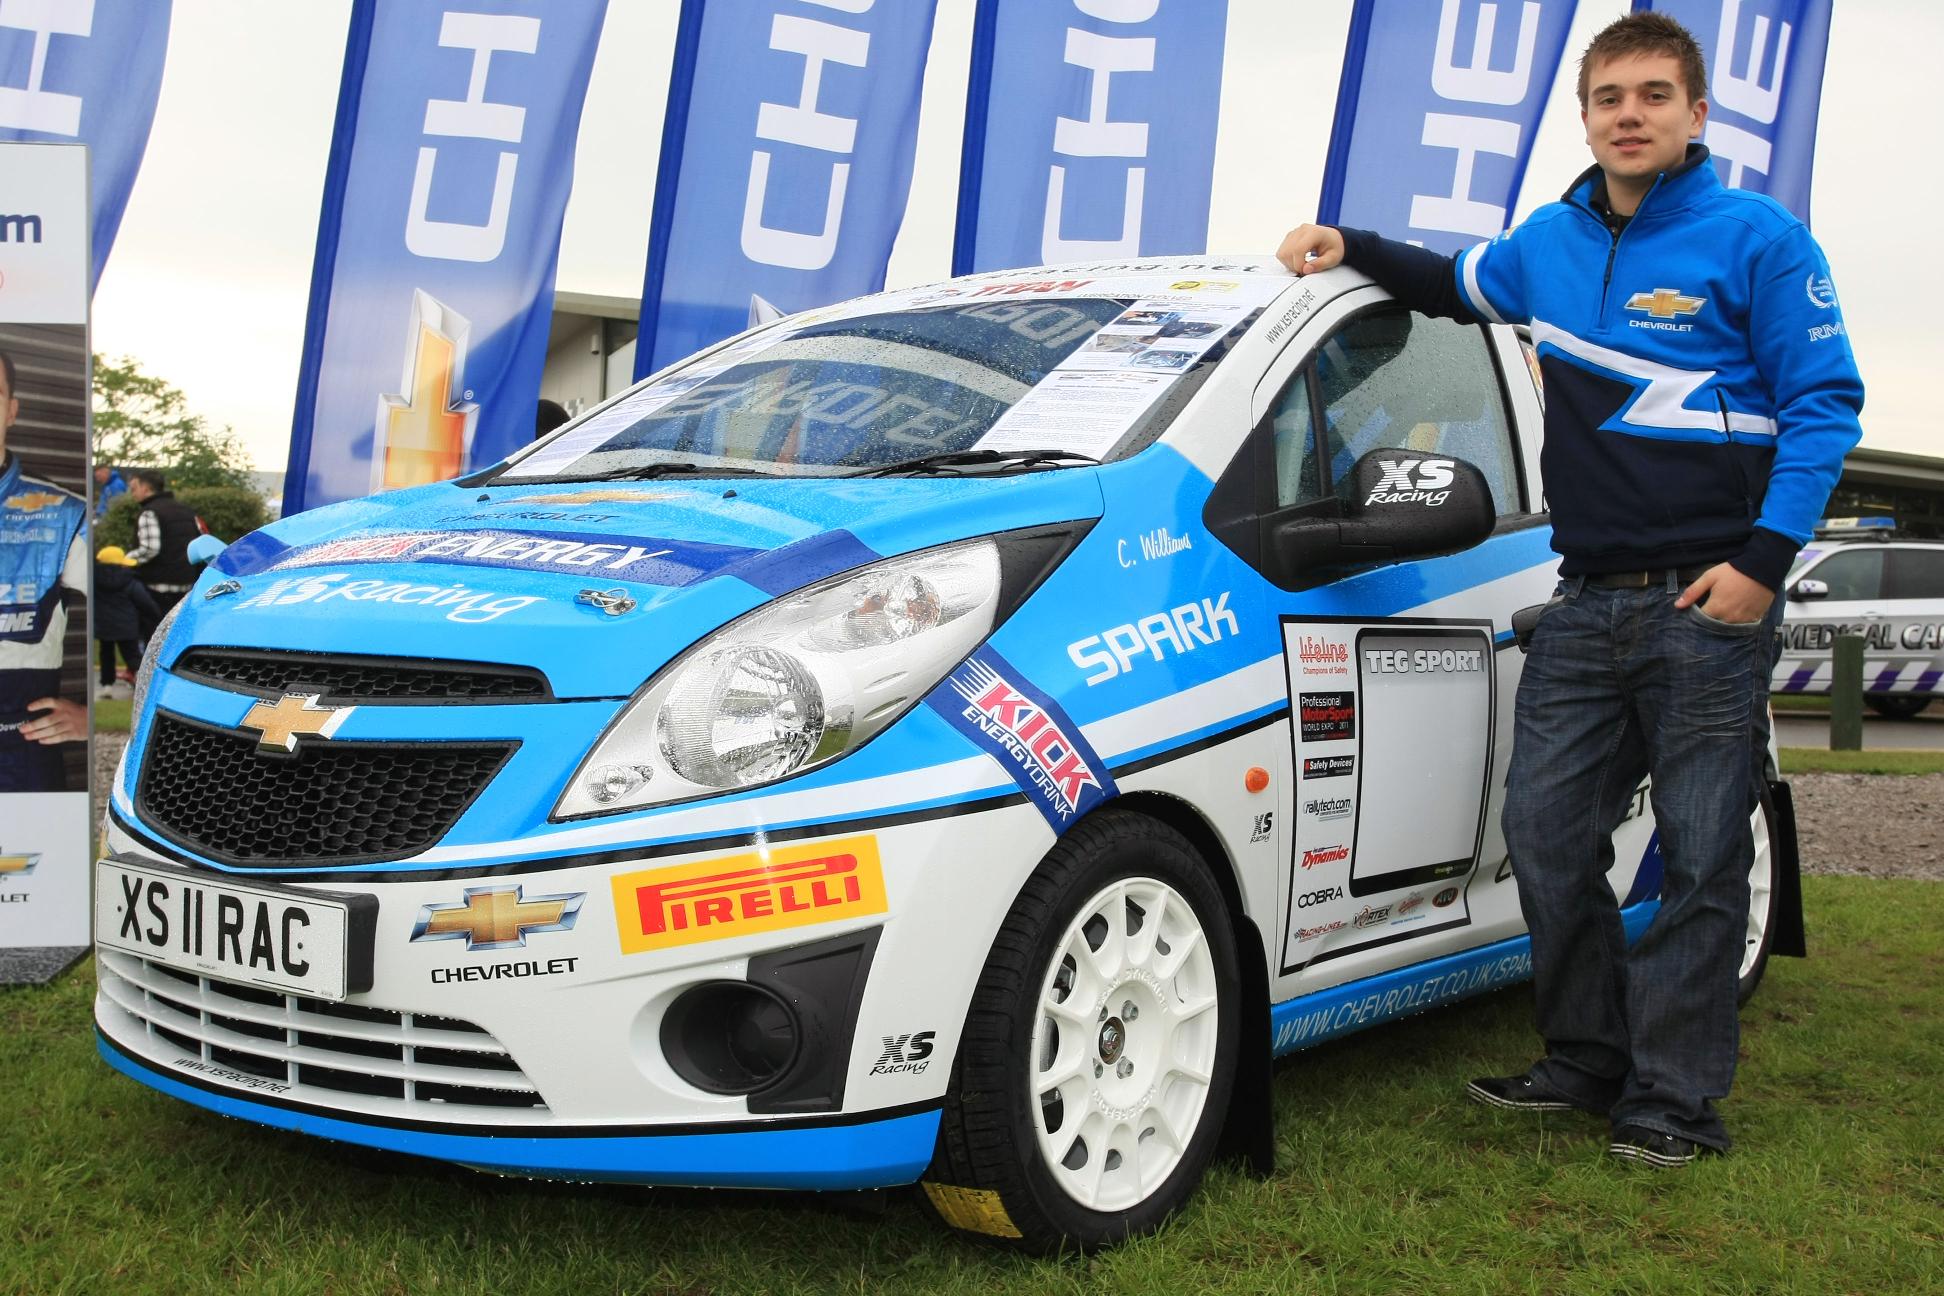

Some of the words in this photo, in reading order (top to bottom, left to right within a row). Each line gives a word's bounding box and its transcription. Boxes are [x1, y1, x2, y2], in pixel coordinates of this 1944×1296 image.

[740, 0, 876, 271] CH
[1403, 0, 1540, 248] HE
[1264, 287, 1316, 344] www.xsracing.net
[1628, 319, 1694, 332] CHEVROLET
[1370, 459, 1455, 493] XS
[1364, 489, 1453, 507] Racing
[5, 511, 58, 521] CHEVROLET
[418, 531, 672, 571] ENERGY
[1117, 538, 1137, 569] C.
[1139, 526, 1193, 562] Williams
[322, 581, 548, 623] Racing
[1066, 591, 1241, 687] SPARK
[1300, 636, 1348, 663] lifeline
[1303, 667, 1328, 676] Champions
[1334, 665, 1348, 676] Safety
[1365, 650, 1409, 674] TEG
[1414, 649, 1484, 673] SPORT
[1301, 695, 1341, 707] Professional
[1302, 706, 1355, 721] MotorSport
[1303, 722, 1321, 732] WORLD
[1321, 722, 1334, 731] EXPO
[1309, 759, 1328, 771] Safety
[1329, 758, 1353, 769] Devices
[1305, 797, 1351, 816] rallytech.com
[1252, 812, 1273, 837] XS
[1301, 848, 1350, 870] Dynamics
[636, 853, 862, 937] PIRELLI
[1297, 885, 1344, 909] COBRA
[119, 874, 170, 948] XS
[217, 893, 311, 978] RAC
[430, 957, 580, 985] CHEVROLET
[875, 1031, 937, 1067] XS
[173, 1058, 292, 1094] www.xsracing.net
[869, 1060, 930, 1076] Racing
